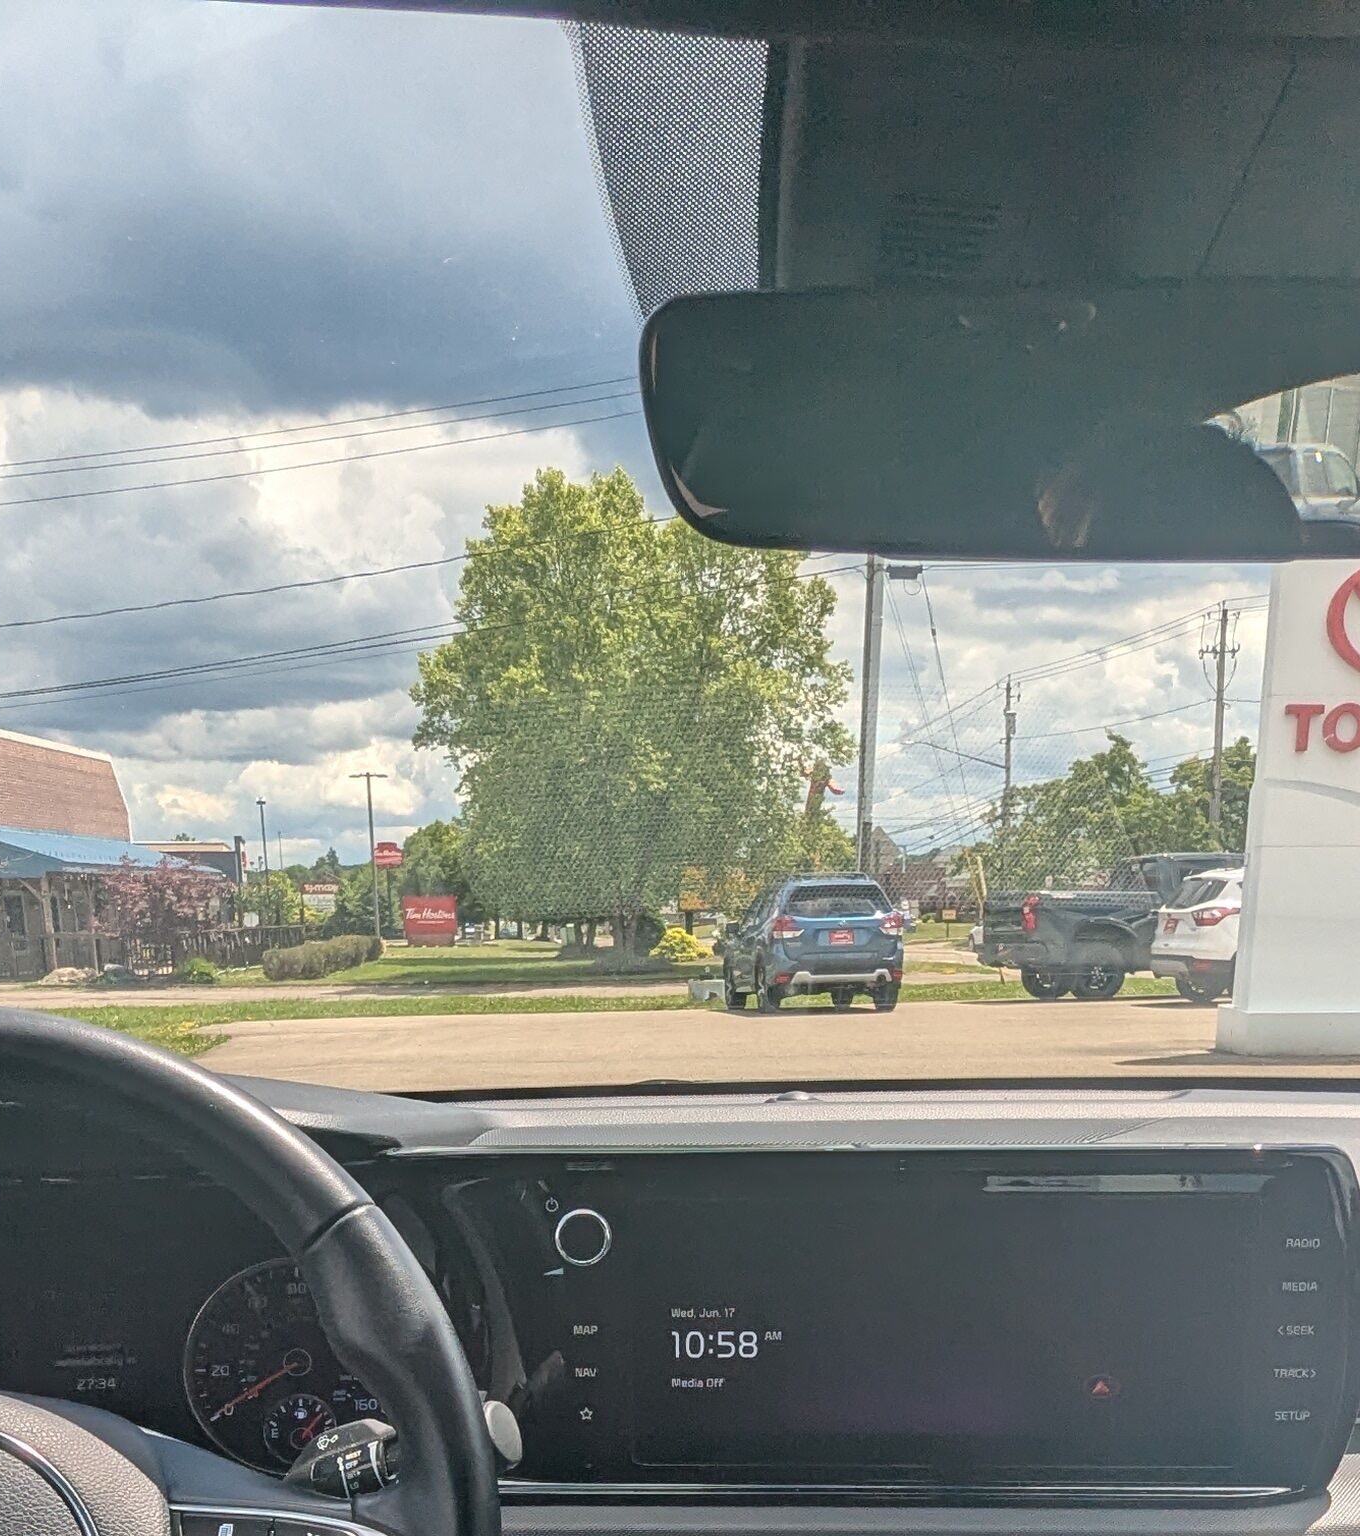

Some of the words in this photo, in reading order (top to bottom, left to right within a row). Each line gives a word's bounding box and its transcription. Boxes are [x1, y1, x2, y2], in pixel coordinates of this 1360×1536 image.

[405, 908, 421, 920] Tim
[423, 907, 455, 920] Hortons
[1285, 1237, 1321, 1249] RADIO
[1281, 1281, 1318, 1292] MEDIA
[723, 1306, 736, 1318] 17
[573, 1324, 599, 1335] MAP
[670, 1330, 759, 1359] 10:58
[764, 1331, 783, 1341] AM
[211, 1364, 230, 1377] 20
[574, 1367, 598, 1378] NAV
[670, 1377, 704, 1388] Media
[705, 1377, 725, 1388] Off
[1274, 1410, 1311, 1422] SETUP
